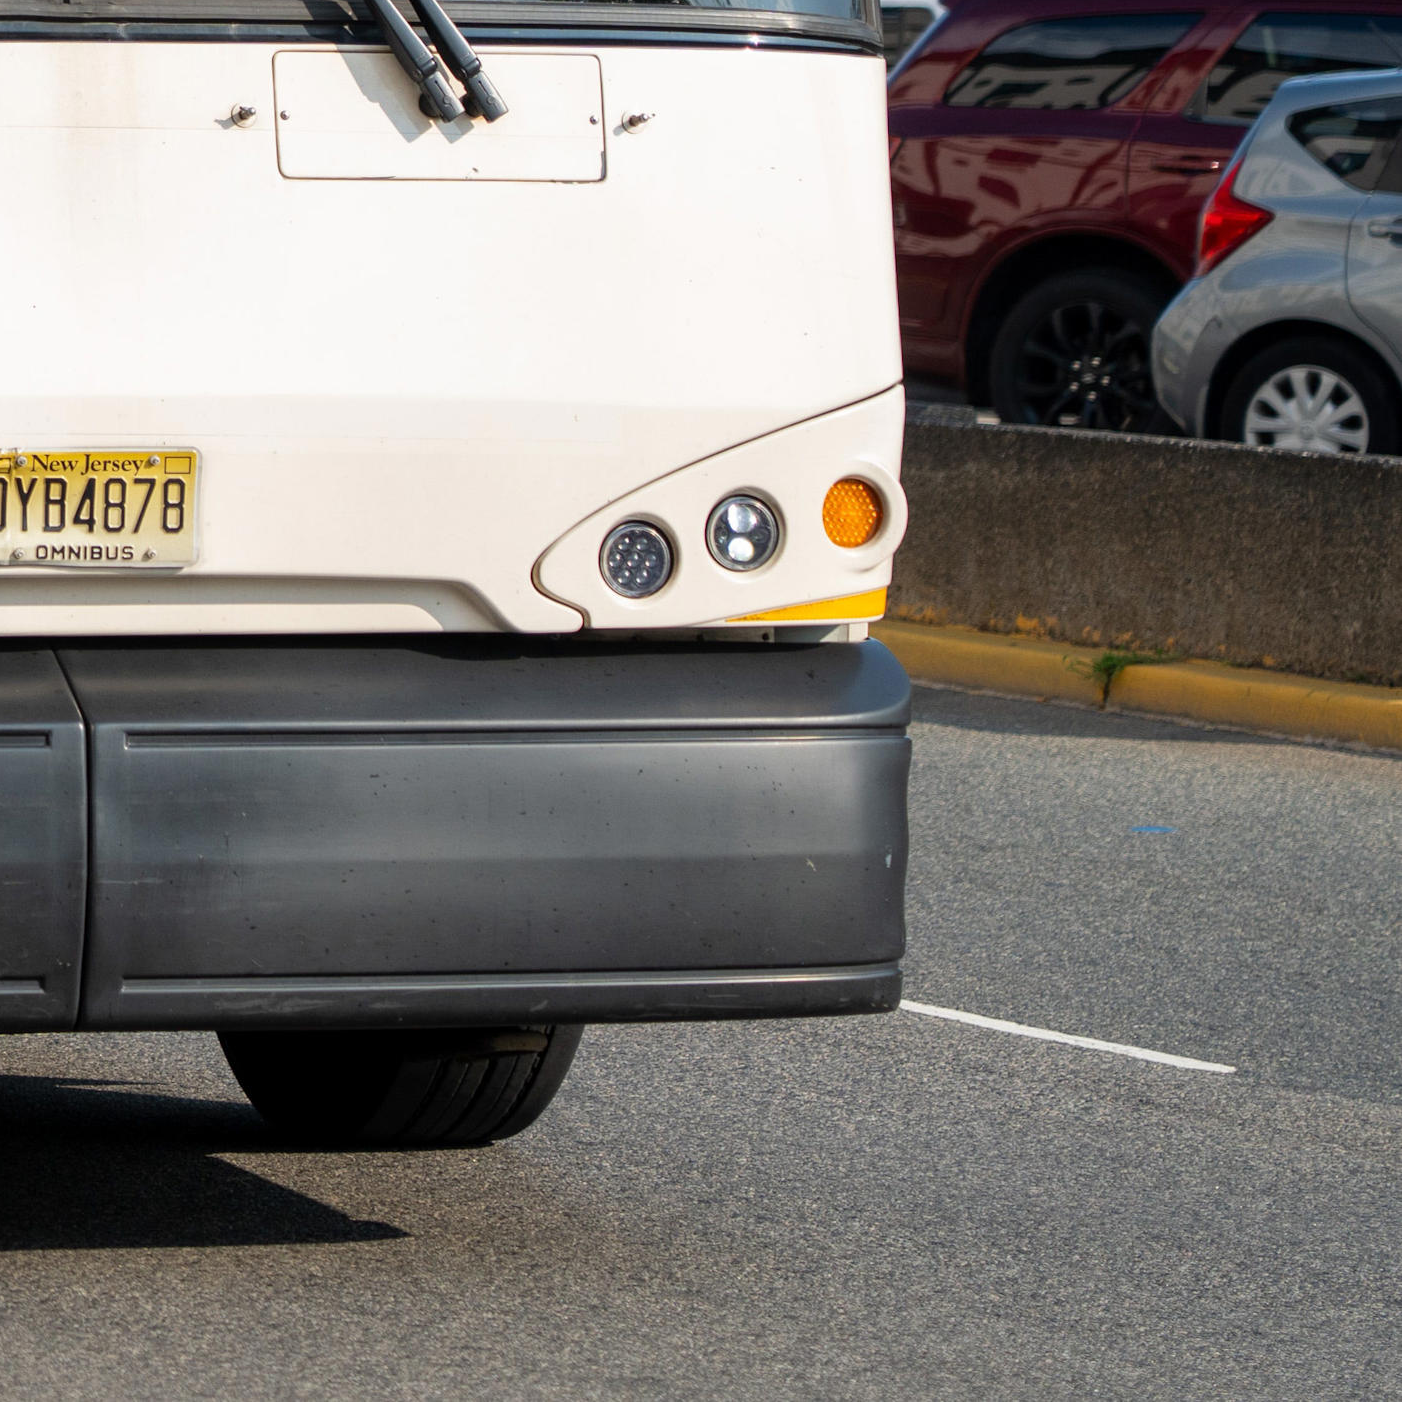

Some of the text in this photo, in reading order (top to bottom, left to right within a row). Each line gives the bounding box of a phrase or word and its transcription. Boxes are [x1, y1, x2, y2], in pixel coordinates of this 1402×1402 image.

[31, 453, 145, 477] New Jersey
[35, 544, 135, 561] OMNIBUS
